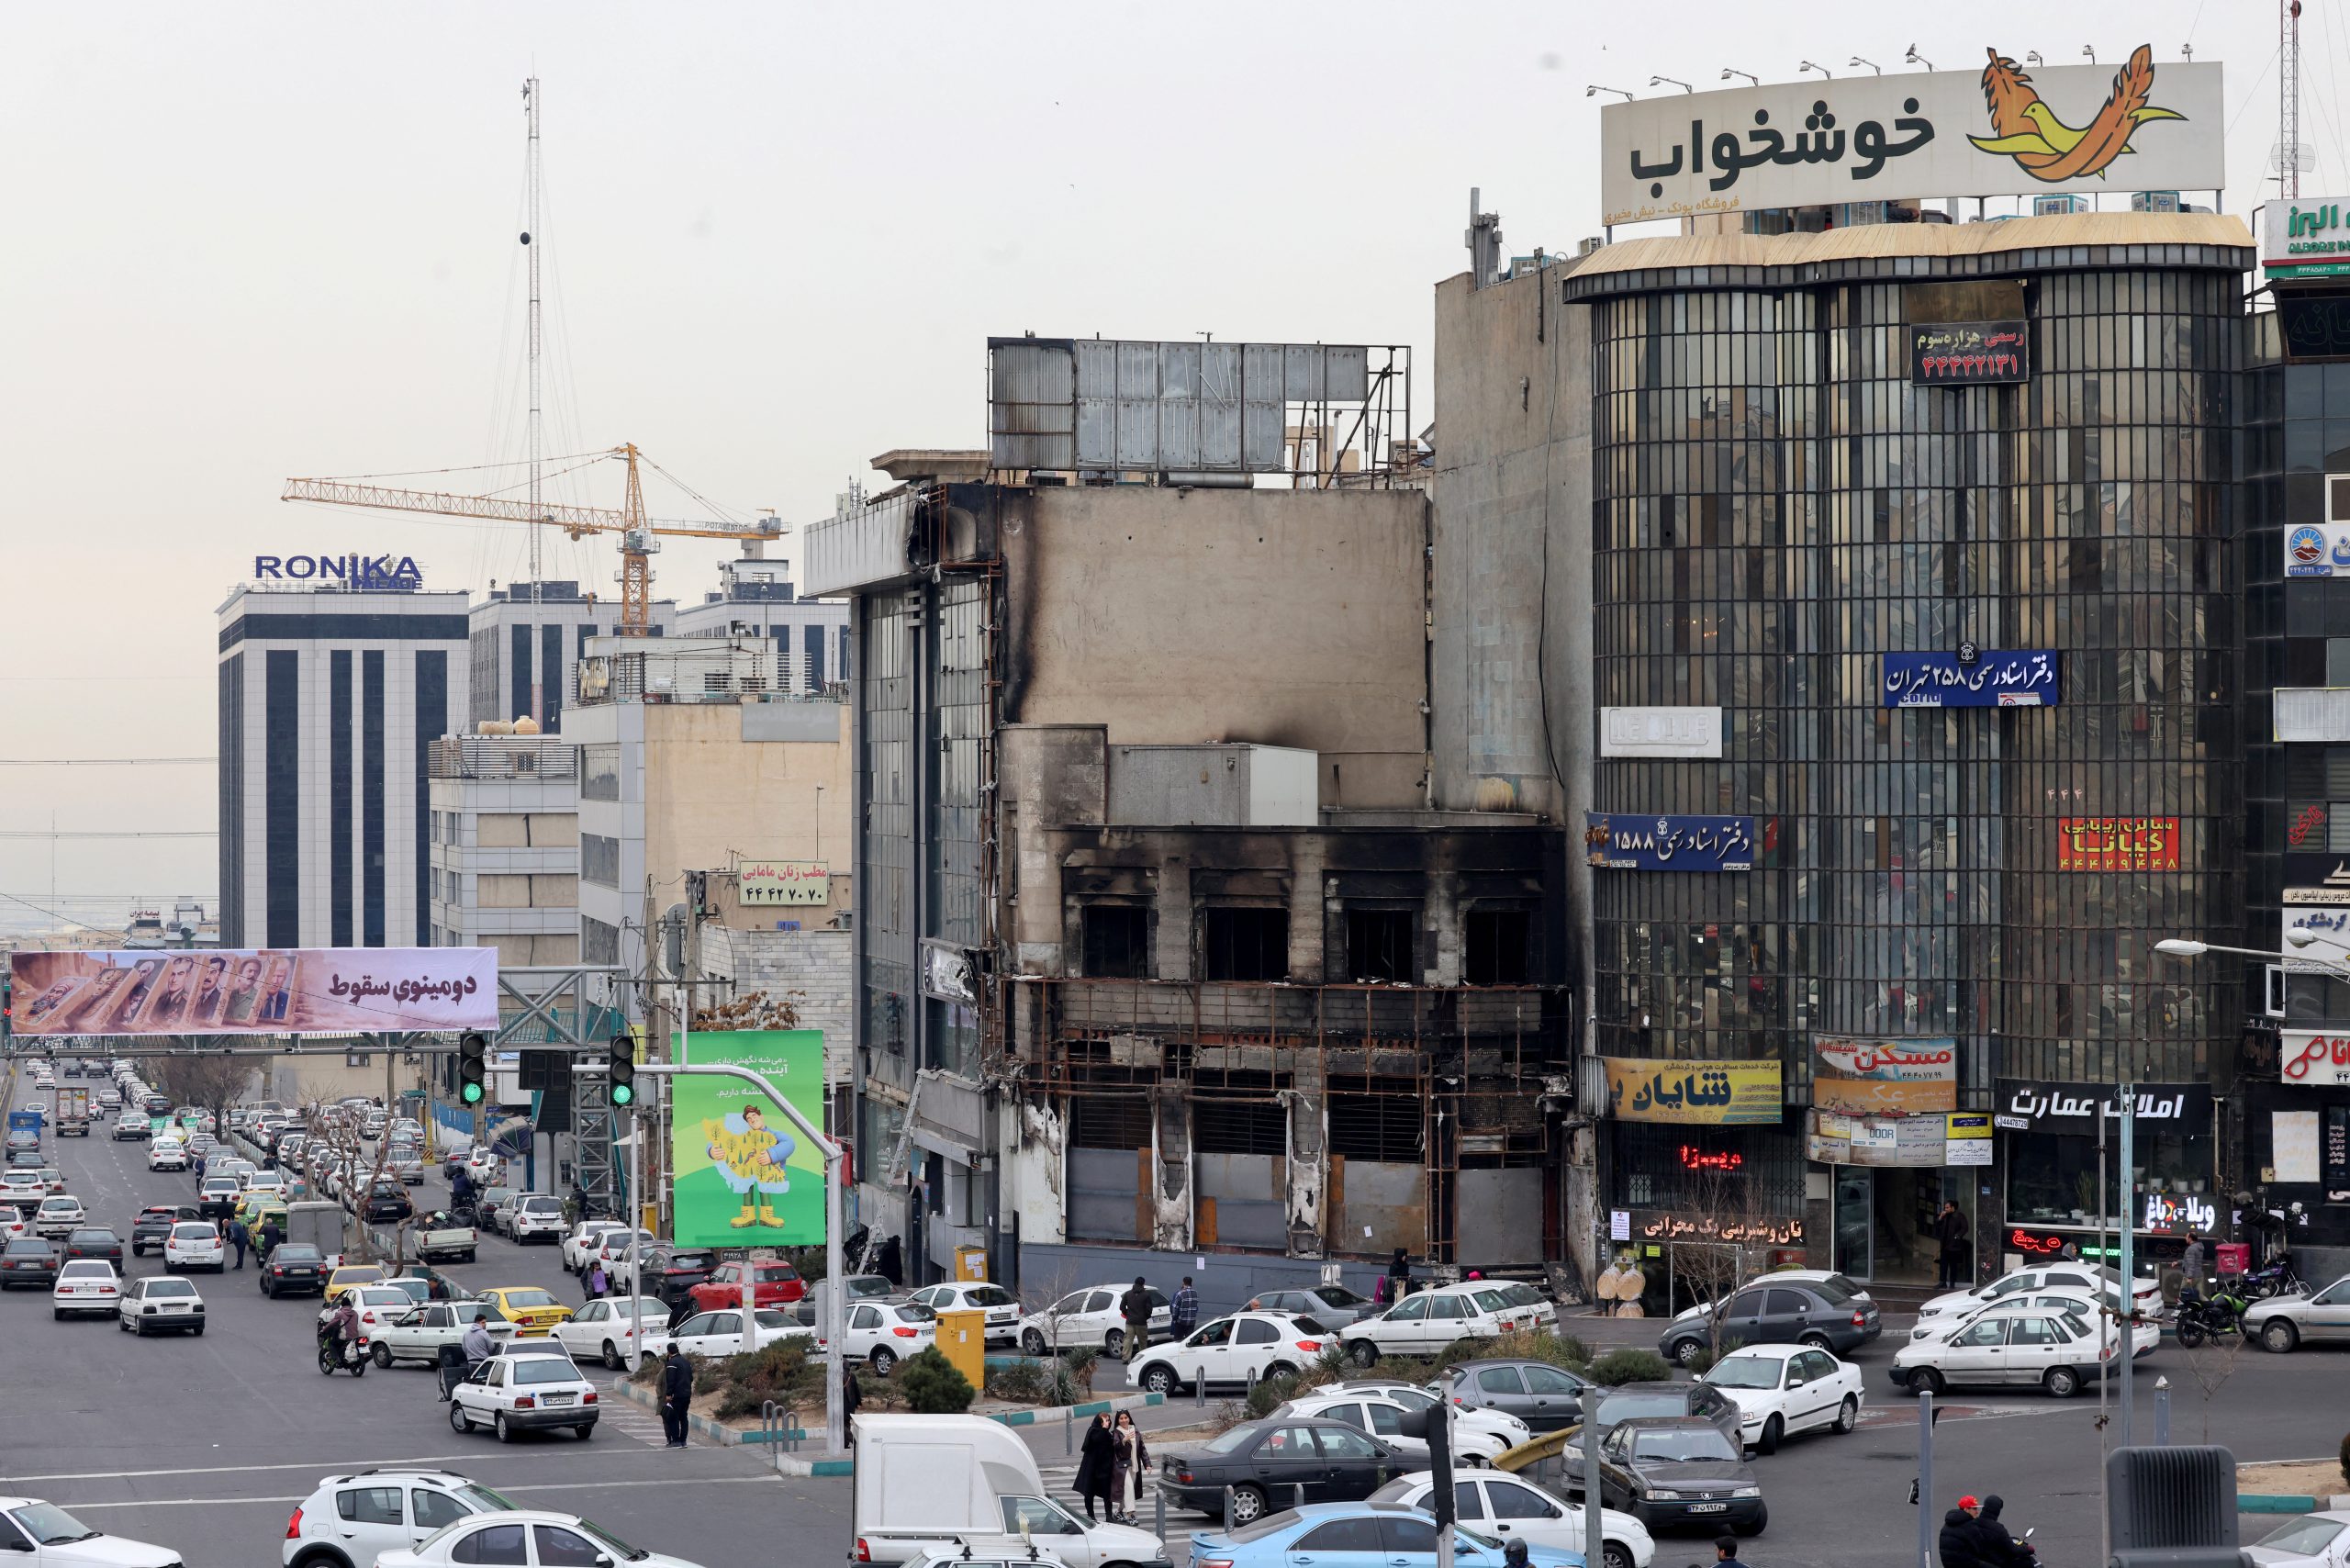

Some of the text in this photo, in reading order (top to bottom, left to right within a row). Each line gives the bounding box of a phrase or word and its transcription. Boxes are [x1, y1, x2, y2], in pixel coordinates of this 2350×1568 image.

[1631, 97, 1935, 199] خوشخواب
[1605, 209, 1631, 223] مخبری
[1634, 206, 1654, 219] نبش
[1667, 202, 1693, 216] پونک
[1695, 197, 1740, 212] فروشگاه
[2288, 204, 2338, 238] البرز
[2288, 241, 2336, 253] ALBORZ
[1984, 331, 2024, 348] رسمی
[1922, 353, 2018, 378] ۴۴۴۴۲۱۳۱
[255, 554, 423, 578] RONIKA
[1886, 654, 2053, 695] دفتر اسناد رسمی ۲۵۸ تهران
[1685, 826, 1719, 851] اسناد
[2065, 819, 2173, 834] سالن زیبایی
[1614, 832, 1654, 850] ۱۵۸۸
[1657, 827, 1684, 861] رسمی
[1716, 821, 1750, 860] دفتر
[742, 864, 827, 881] مطب زنان مامایی
[2060, 858, 2177, 869] ۴۴۴۲۹۴۴۸
[329, 973, 391, 1007] سقوط
[393, 975, 477, 1009] دومینوی
[1663, 1063, 1690, 1071] گردشگری
[1853, 1043, 1952, 1072] مسکن
[759, 1064, 789, 1077] آینده
[1632, 1071, 1731, 1111] شایان
[2010, 1089, 2185, 1119] املاک عمارت
[2003, 1117, 2028, 1128] 44478729
[1777, 1218, 1803, 1244] نان
